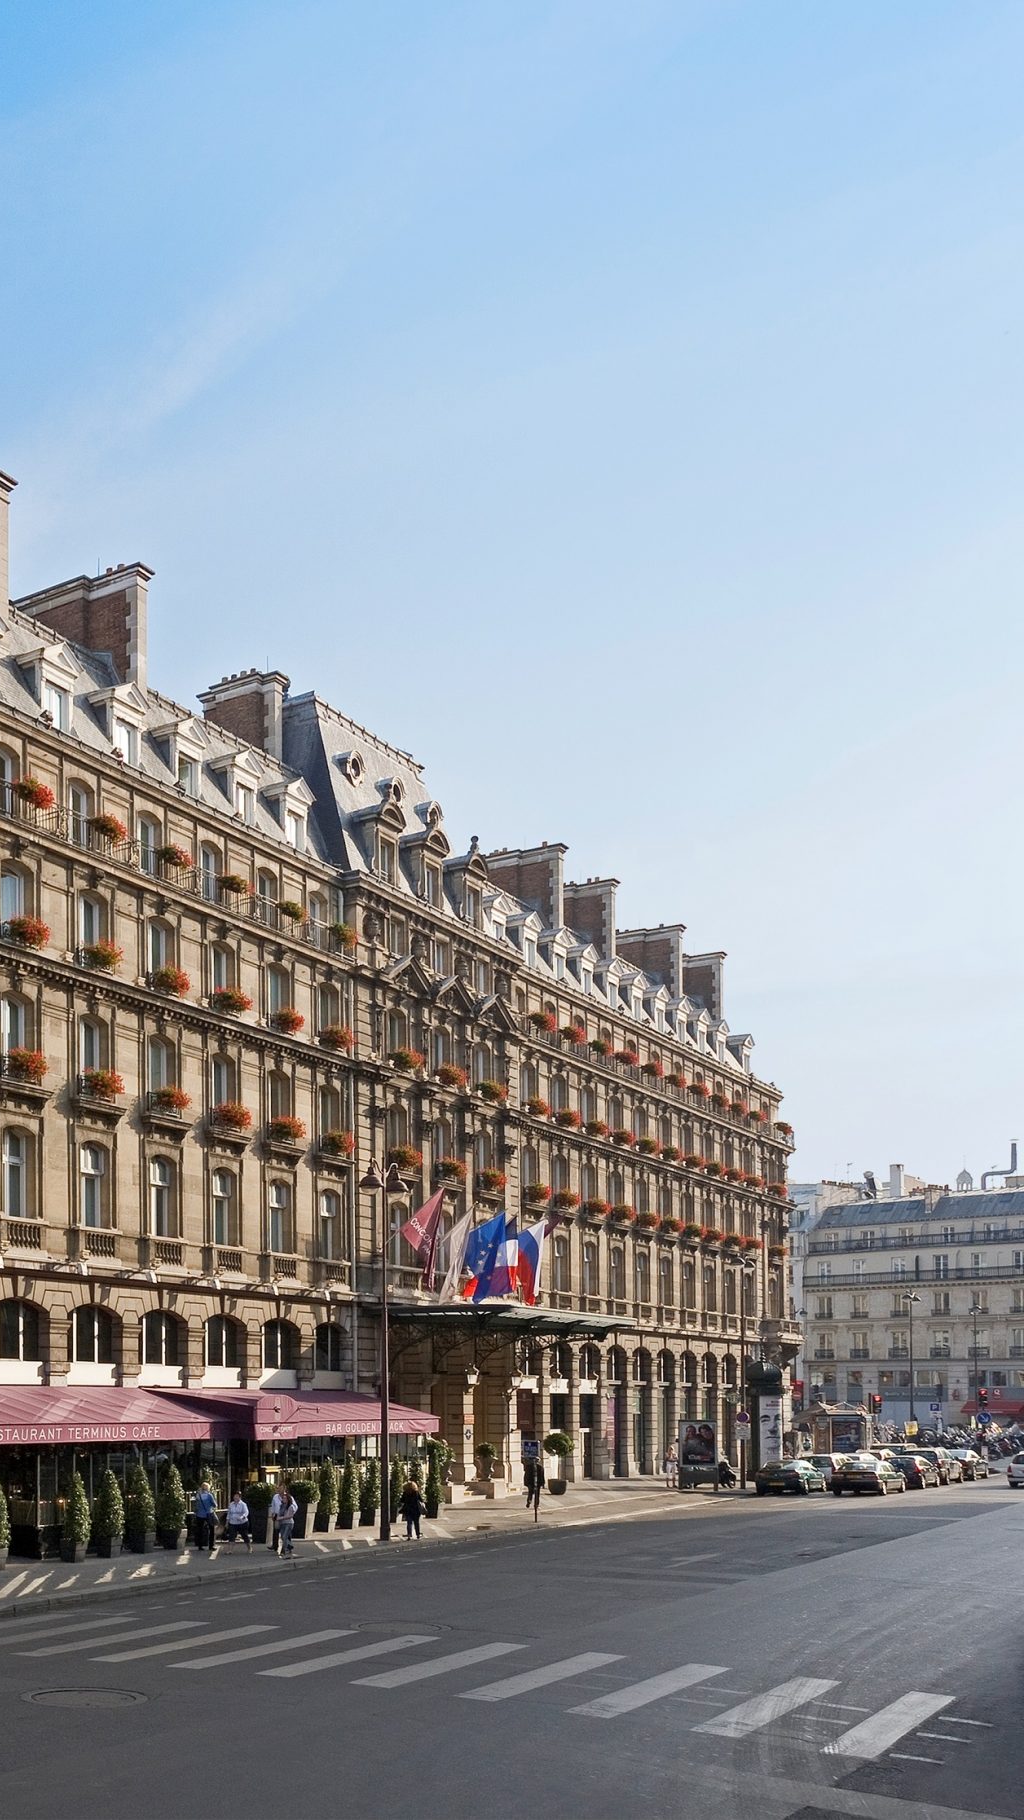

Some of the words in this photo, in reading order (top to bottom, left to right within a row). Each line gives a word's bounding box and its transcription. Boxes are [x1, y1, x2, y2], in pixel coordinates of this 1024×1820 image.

[68, 1426, 127, 1440] TERMINUS
[132, 1426, 161, 1438] CAFE
[325, 1423, 342, 1433] BAR
[345, 1422, 376, 1433] GOLDEN
